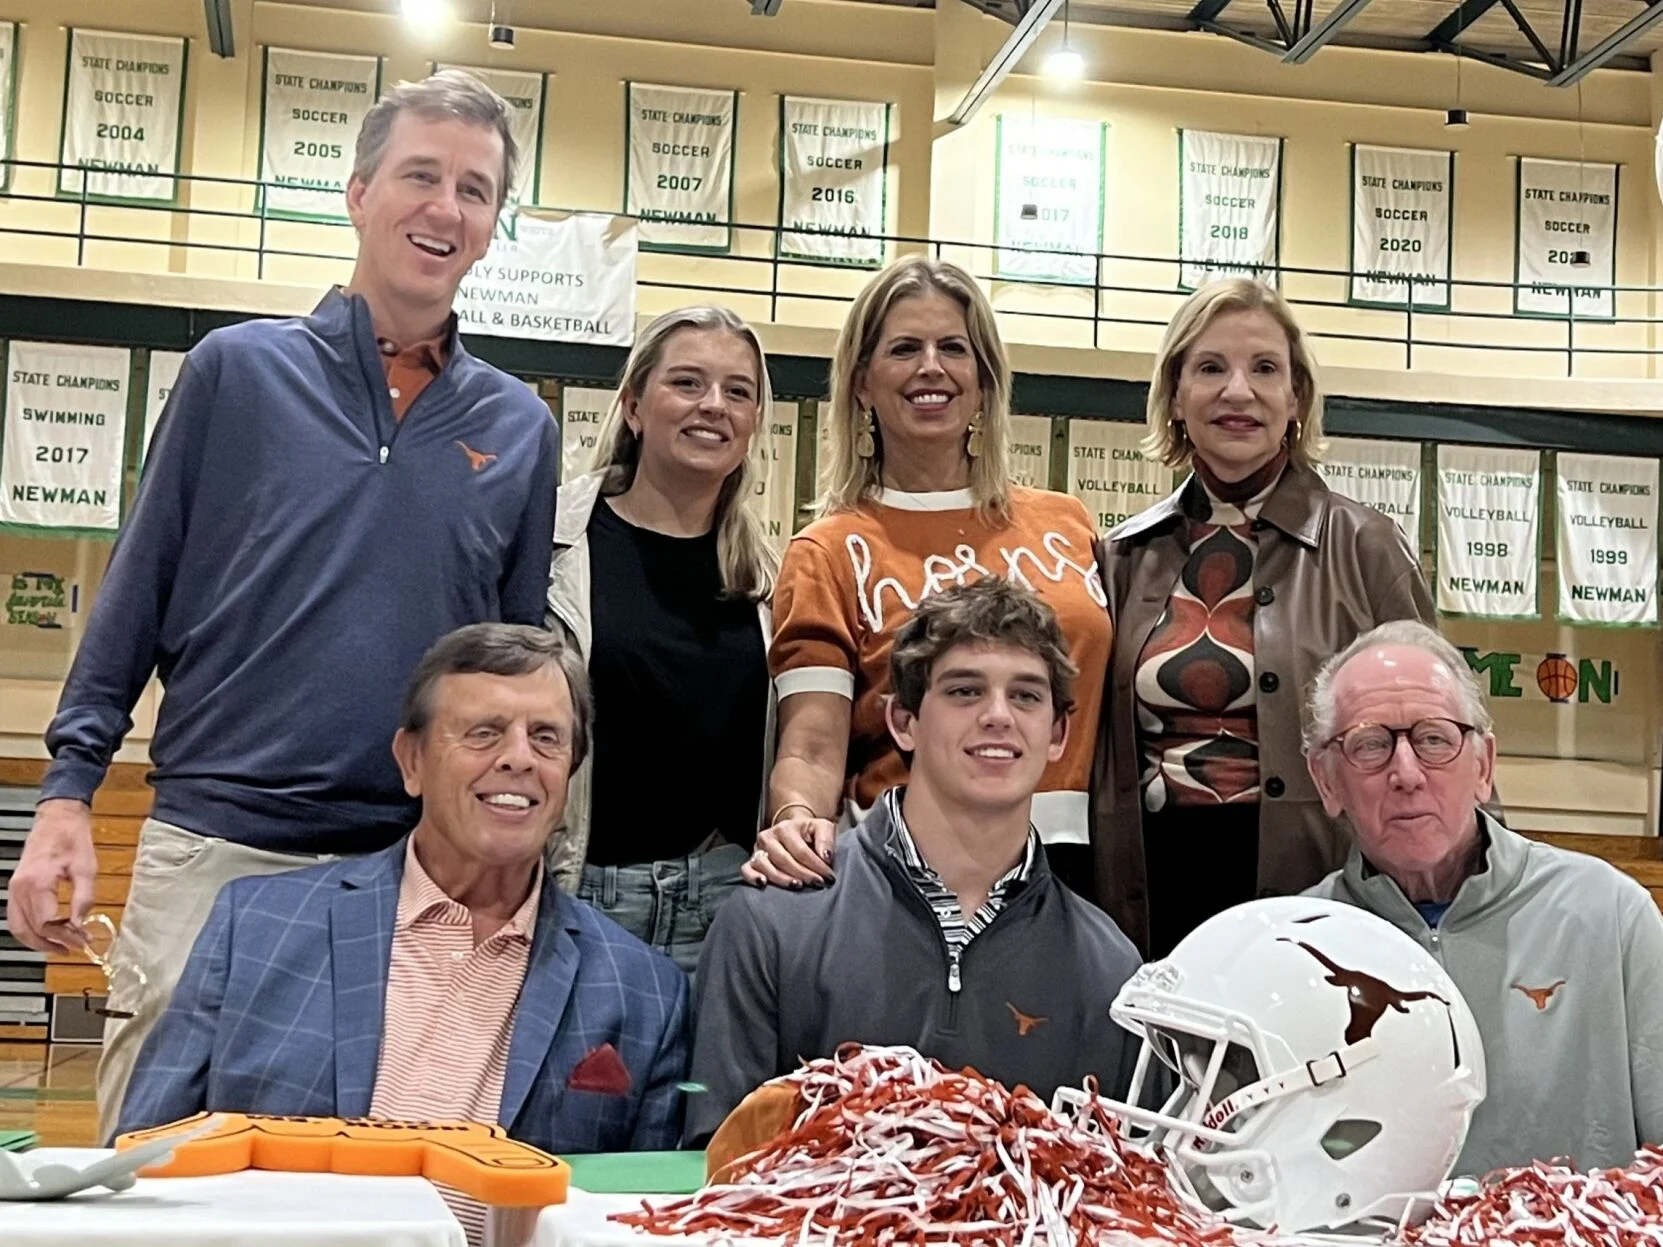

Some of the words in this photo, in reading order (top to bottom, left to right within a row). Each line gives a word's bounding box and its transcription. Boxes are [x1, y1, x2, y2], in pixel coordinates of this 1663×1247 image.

[82, 56, 112, 71] STATE
[116, 59, 169, 75] CHAMPIONS
[275, 74, 304, 88] STATE
[309, 78, 367, 94] CHAMPIONS
[94, 90, 154, 107] SOCCER
[292, 108, 348, 124] SOCCER
[642, 109, 667, 123] STATE
[673, 112, 722, 127] CHAMPIONS
[96, 123, 145, 141] 2004
[792, 123, 818, 136] STATE
[823, 126, 876, 141] CHAMPIONS
[294, 141, 343, 159] 2005
[652, 142, 710, 158] SOCCER
[78, 158, 159, 177] NEWMAN
[808, 155, 862, 170] SOCCER
[1190, 162, 1217, 175] STATE
[1222, 166, 1270, 179] CHAMPIONS
[657, 175, 702, 191] 2007
[1362, 175, 1386, 189] STATE
[1392, 179, 1443, 193] CHAMPIONS
[812, 187, 854, 204] 2016
[1205, 194, 1256, 209] SOCCER
[1525, 188, 1555, 201] STATE
[1559, 191, 1610, 205] CHAMPIONS
[640, 208, 716, 227] NEWMAN
[1375, 207, 1428, 222] SOCCER
[794, 221, 870, 239] NEWMAN
[1210, 225, 1248, 240] 2018
[1545, 220, 1590, 234] SOCCER
[1380, 238, 1422, 252] 2020
[498, 268, 584, 287] SUPPORTS
[458, 286, 538, 305] NEWMAN
[492, 312, 504, 325] &
[510, 314, 612, 335] BASKETBALL
[13, 371, 50, 386] STATE
[57, 375, 120, 391] CHAMPIONS
[23, 408, 105, 426] SWIMMING
[568, 411, 599, 424] STATE
[36, 446, 89, 464] 2017
[1074, 446, 1105, 460] STATE
[1324, 465, 1353, 478] STATE
[1359, 468, 1413, 481] CHAMPIONS
[1445, 472, 1473, 486] STATE
[1481, 475, 1532, 488] CHAMPIONS
[13, 485, 106, 506] NEWMAN
[1078, 479, 1160, 495] VOLLEYBALL
[1567, 481, 1594, 493] STATE
[1600, 482, 1651, 496] CHAMPIONS
[1446, 506, 1530, 522] VOLLEYBALL
[1570, 514, 1648, 529] VOLLEYBALL
[1467, 541, 1508, 558] 1998
[1591, 549, 1628, 565] 1999
[845, 533, 1108, 633] horns
[1450, 577, 1524, 595] NEWMAN
[1572, 585, 1646, 602] NEWMAN
